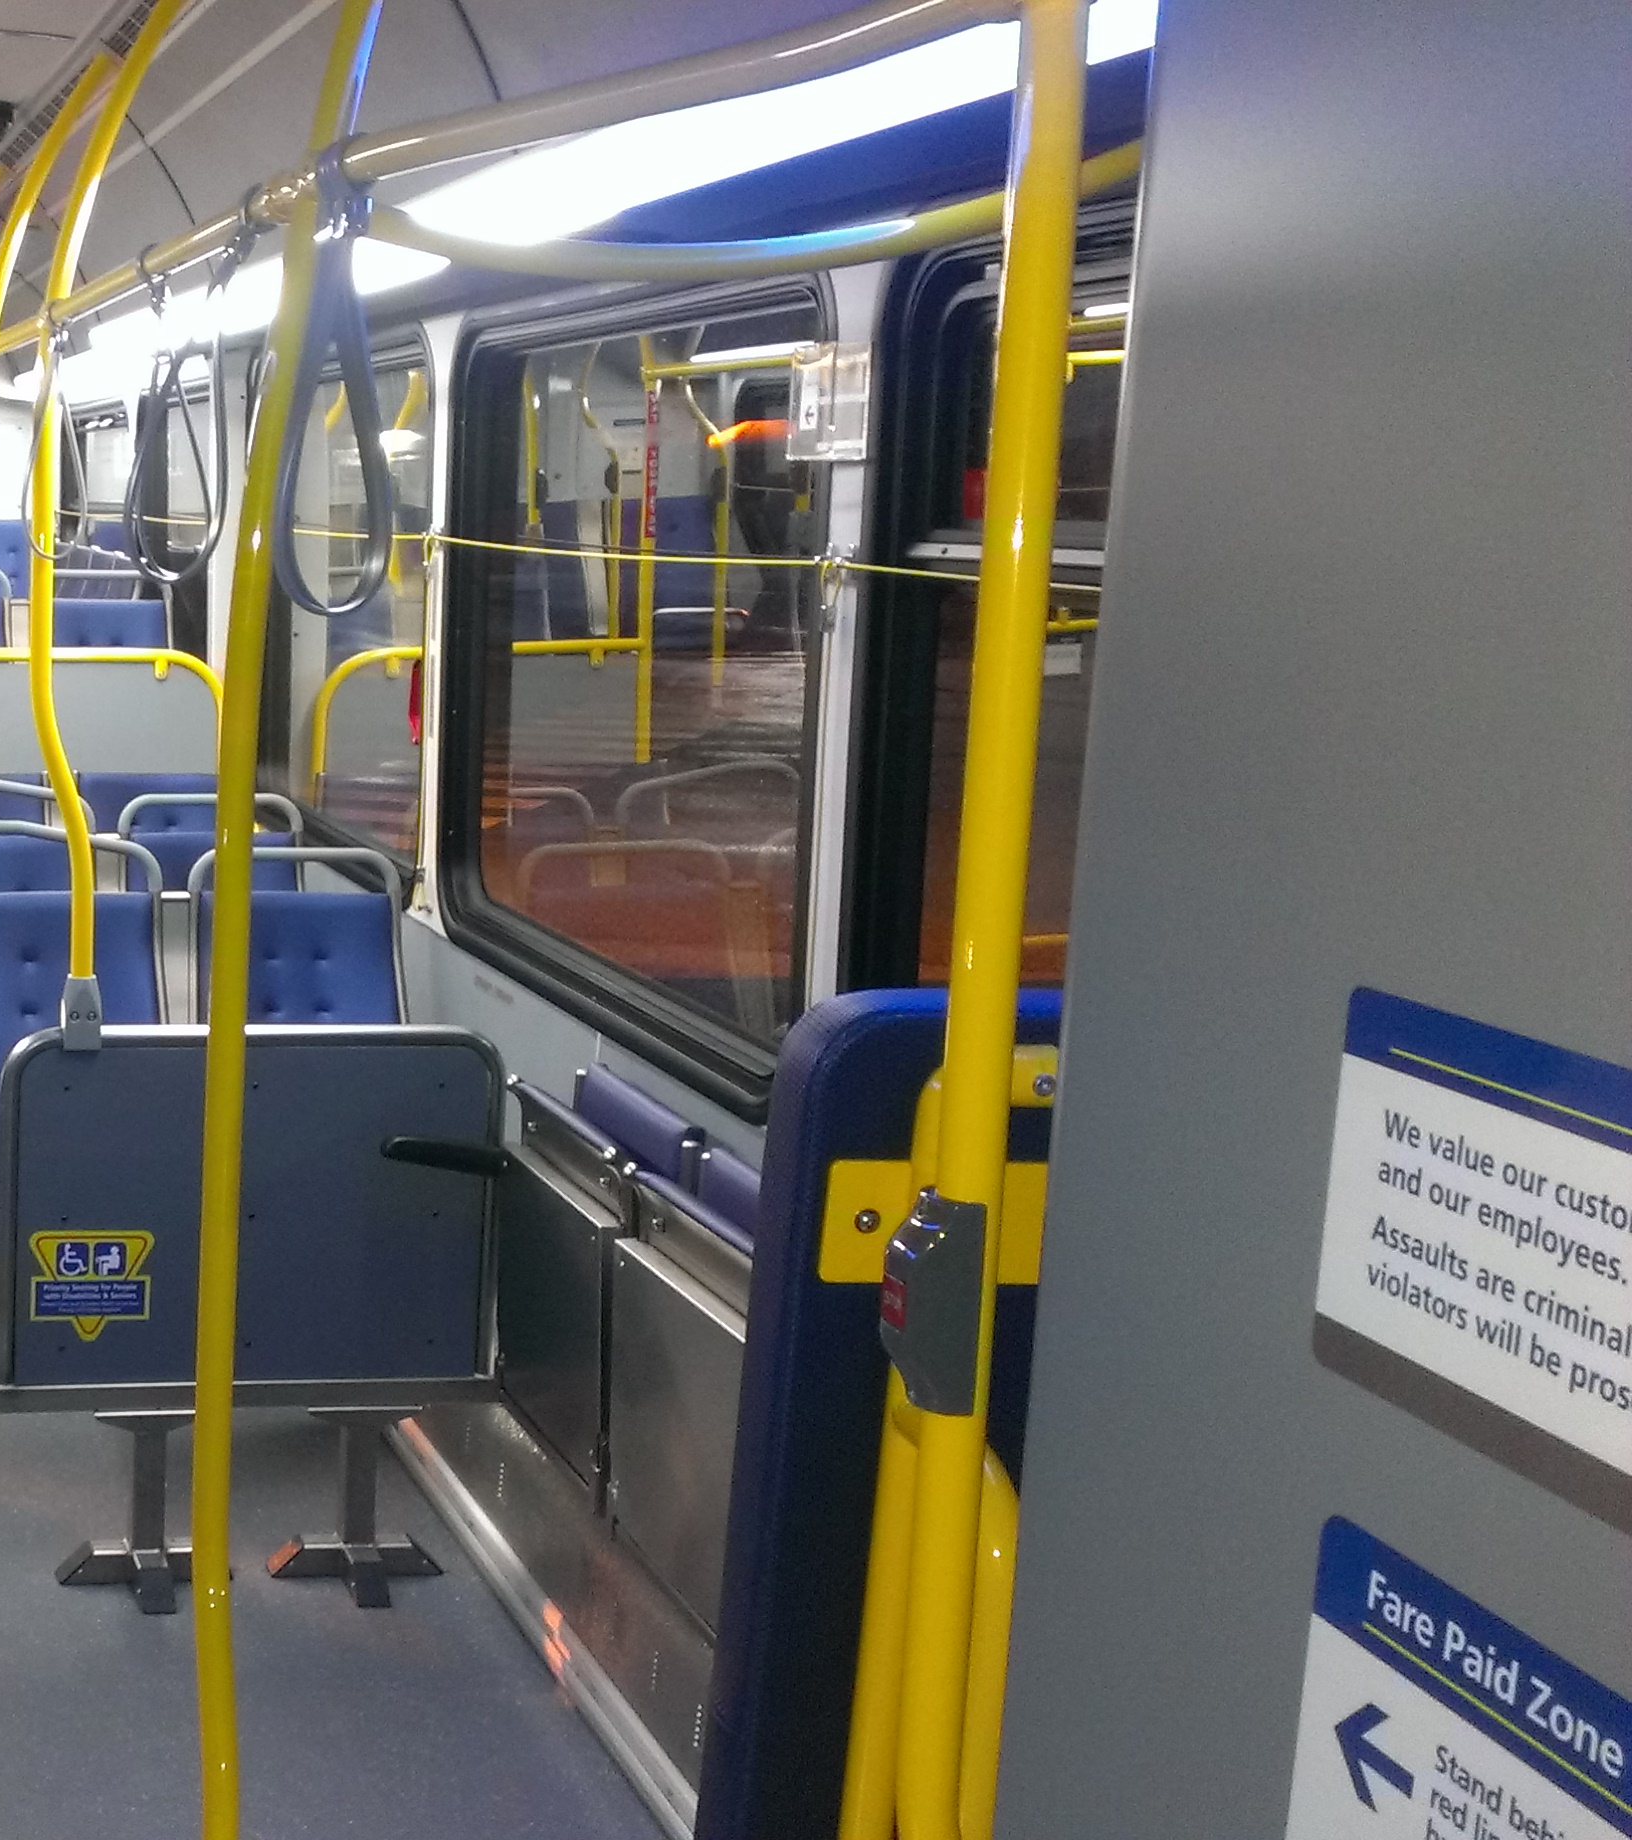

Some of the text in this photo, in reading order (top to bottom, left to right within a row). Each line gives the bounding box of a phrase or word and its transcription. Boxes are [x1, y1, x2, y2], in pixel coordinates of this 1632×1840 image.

[1378, 1160, 1627, 1285] and our employees.
[1384, 1108, 1632, 1233] We value our custo
[1367, 1261, 1632, 1410] violators will be pros
[1371, 1214, 1632, 1357] Assaults are criminal
[1368, 1570, 1624, 1778] Fare Paid Zone
[1430, 1788, 1468, 1831] red
[1435, 1744, 1564, 1840] Stand beh
